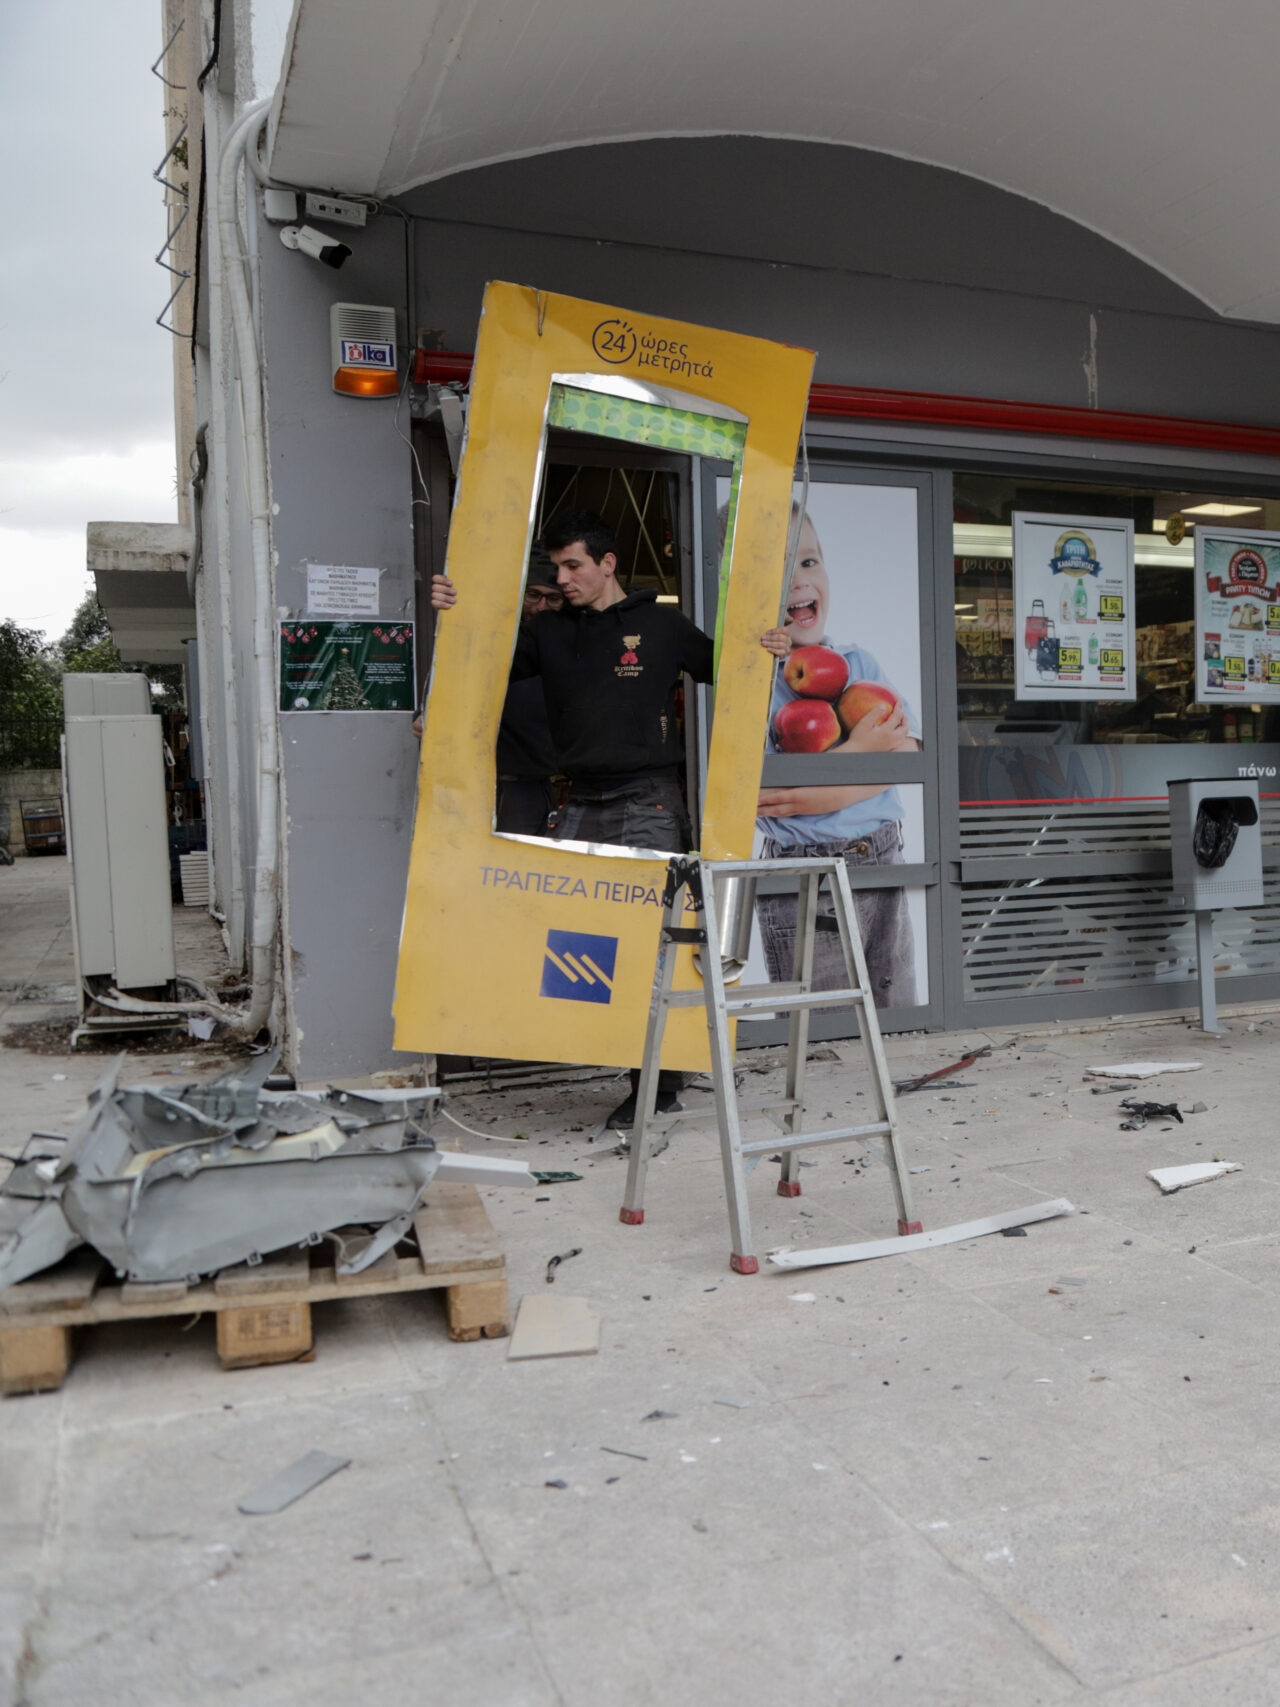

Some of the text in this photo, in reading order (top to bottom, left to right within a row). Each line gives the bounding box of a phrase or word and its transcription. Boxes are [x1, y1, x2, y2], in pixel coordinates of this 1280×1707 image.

[601, 330, 689, 359] 24 ώρες
[638, 351, 714, 378] μετρητά
[1065, 544, 1085, 556] ΤΡΙΤΗ
[1226, 586, 1271, 599] PARTY TIMON
[1238, 763, 1279, 778] πάνω
[480, 866, 587, 898] ΤΡΑΠΕΖΑ
